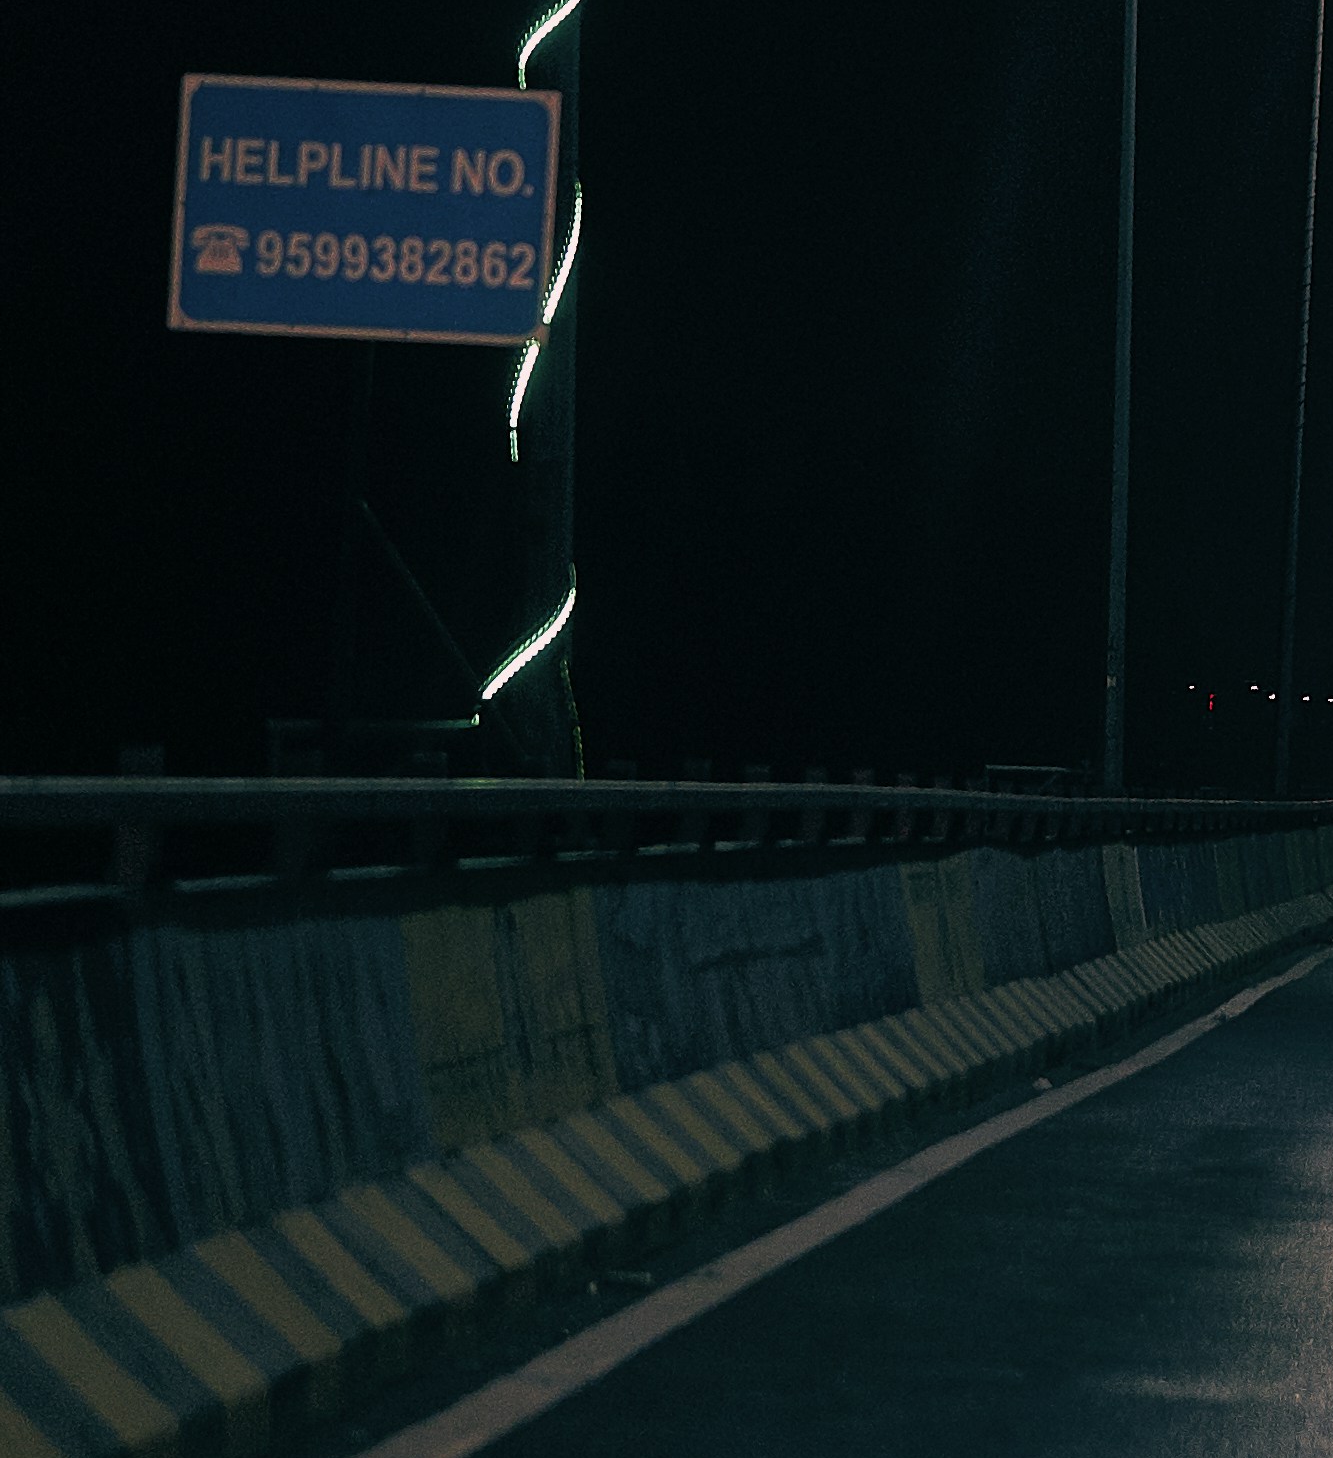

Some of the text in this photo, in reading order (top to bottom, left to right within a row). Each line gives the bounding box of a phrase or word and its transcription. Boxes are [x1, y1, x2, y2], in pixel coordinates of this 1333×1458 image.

[200, 137, 535, 197] HELPLINE NO.
[257, 230, 536, 289] 9599382862
